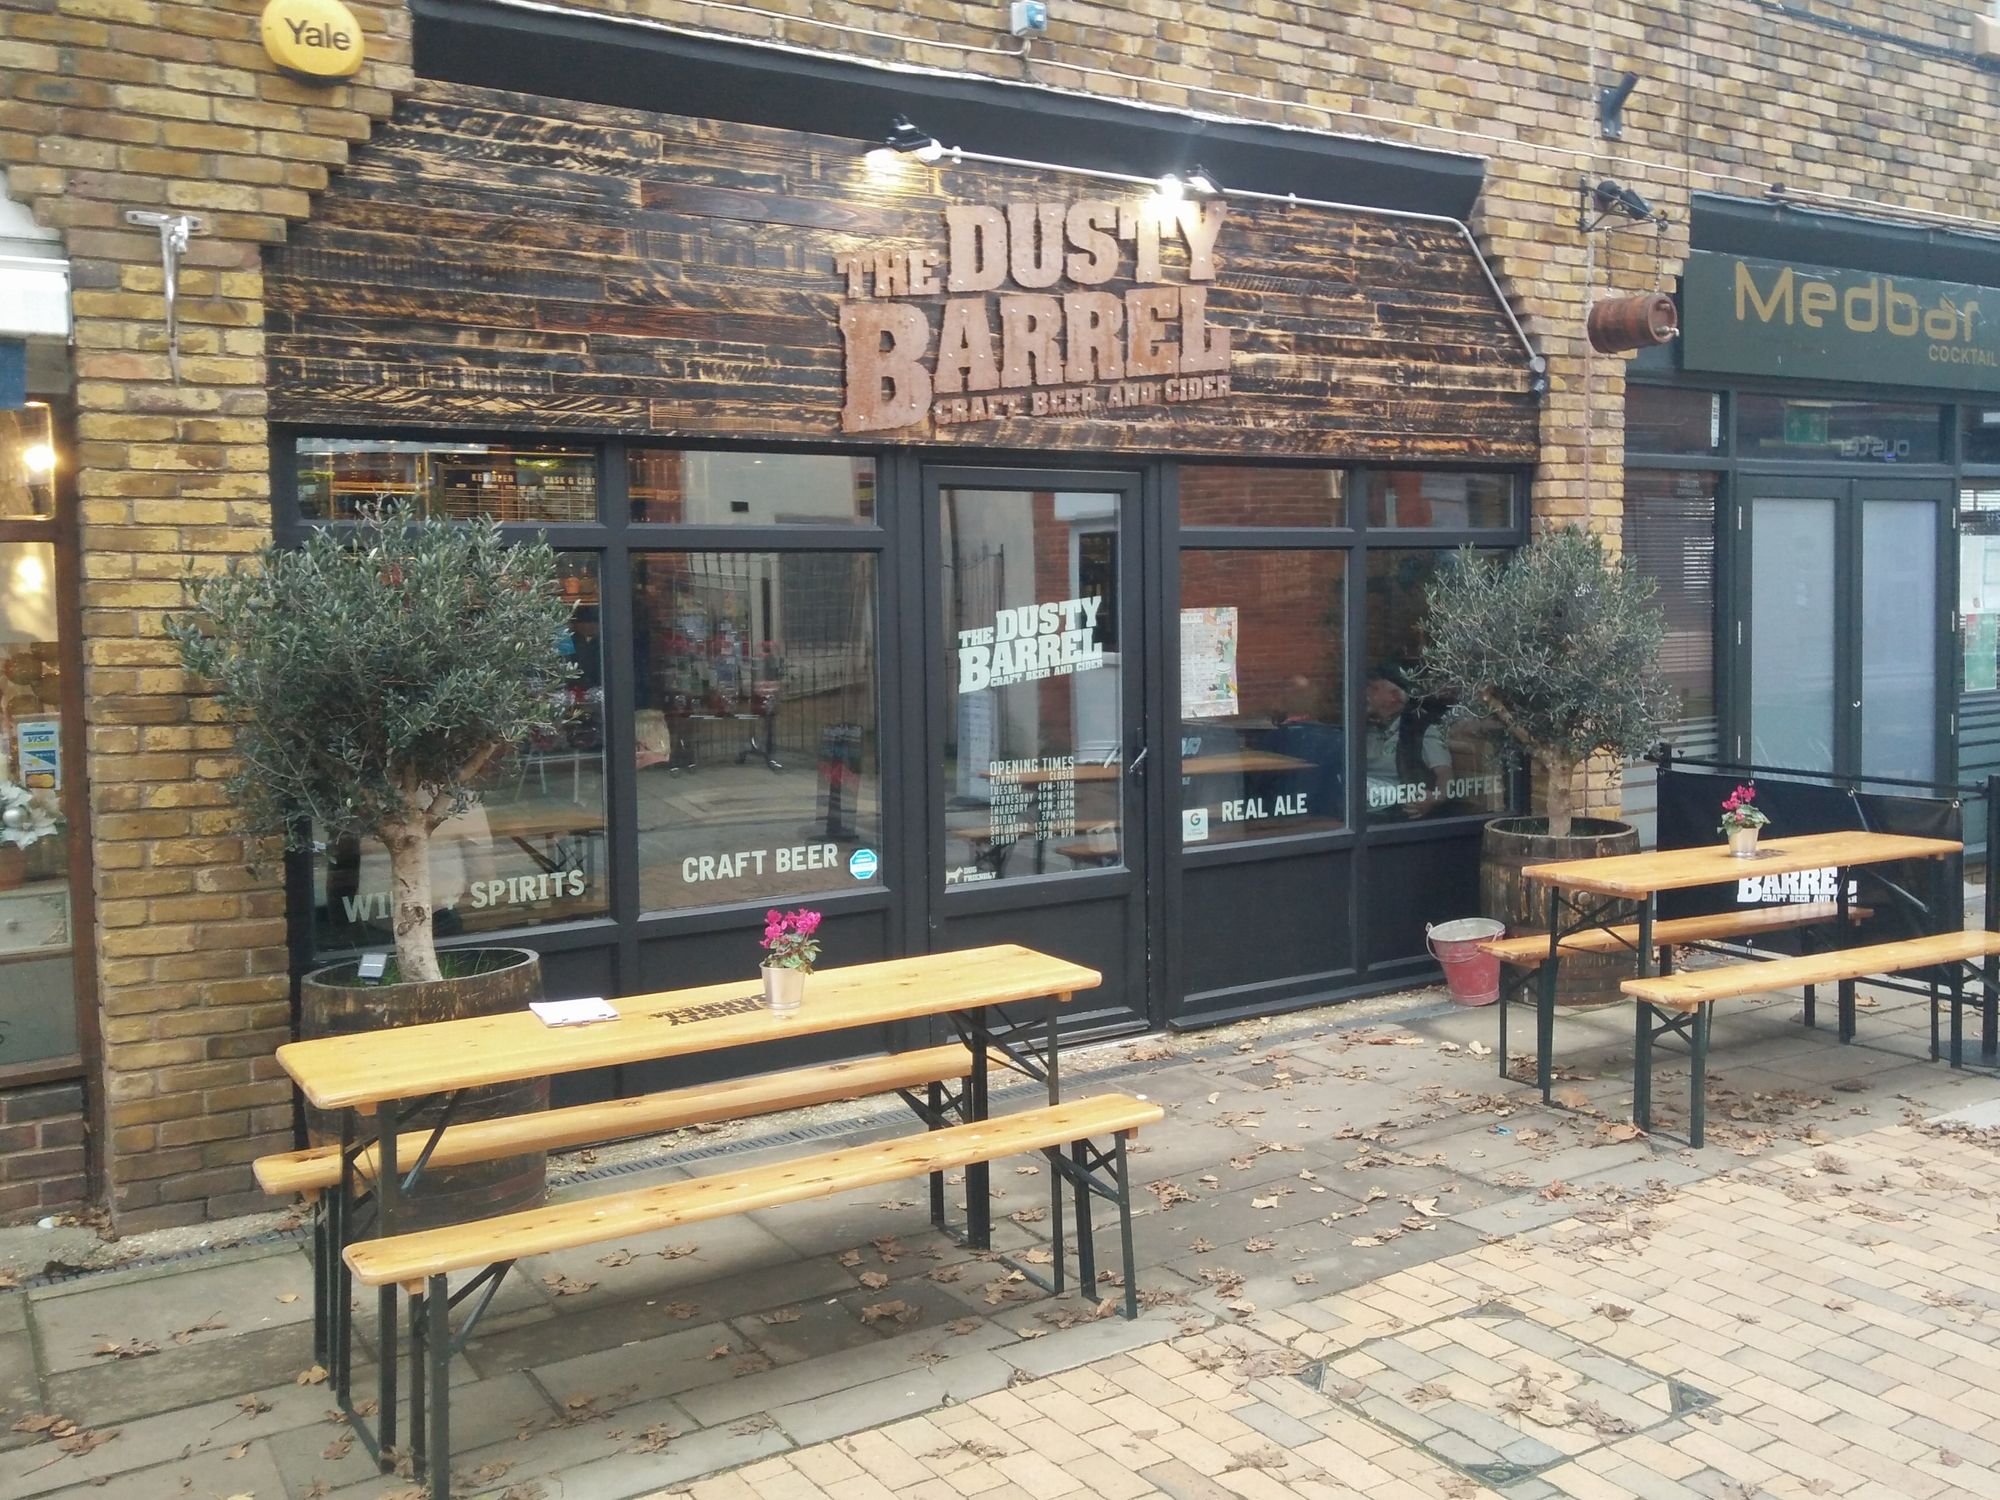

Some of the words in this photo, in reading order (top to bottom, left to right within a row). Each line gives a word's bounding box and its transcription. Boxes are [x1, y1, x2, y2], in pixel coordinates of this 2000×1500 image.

[284, 17, 351, 51] Yale
[833, 249, 940, 299] THE
[946, 200, 1228, 293] DUSTY
[1735, 260, 1980, 343] Medbar
[840, 286, 1232, 433] BARREL
[1928, 344, 1999, 368] COCKTAIL
[933, 395, 1026, 425] CRAFT
[1031, 387, 1099, 417] BEER
[1107, 382, 1162, 409] AND
[1165, 375, 1232, 402] CIDER
[958, 626, 994, 647] THE
[996, 595, 1102, 642] DUSTY
[958, 628, 1102, 694] BARREL
[990, 673, 1022, 687] CRAFT
[1026, 668, 1051, 681] BEER
[1054, 664, 1073, 676] AND
[1076, 659, 1103, 672] CIDER
[28, 735, 50, 743] VISA
[990, 759, 1039, 776] OPENING
[1042, 756, 1075, 771] TIMES
[990, 775, 1020, 785] MONDAY
[1050, 770, 1075, 780] CLOSED
[990, 784, 1022, 795] TUESDAY
[990, 793, 1034, 805] WEDNESDAY
[1369, 782, 1427, 808] CIDERS
[1432, 786, 1442, 800] +
[1446, 775, 1503, 799] COFFEE
[990, 804, 1028, 815] THURSDAY
[990, 815, 1017, 826] FRIDAY
[1222, 797, 1268, 822] REAL
[1274, 793, 1308, 816] ALE
[990, 822, 1028, 835] SATURDAY
[990, 834, 1019, 845] SUNDAY
[682, 850, 767, 883] CRAFT
[775, 843, 839, 873] BEER
[470, 869, 586, 909] SPIRITS
[1737, 866, 1857, 902] BARRE
[1761, 894, 1788, 903] CRAFT
[1790, 894, 1810, 903] BEER
[1814, 893, 1829, 903] AND
